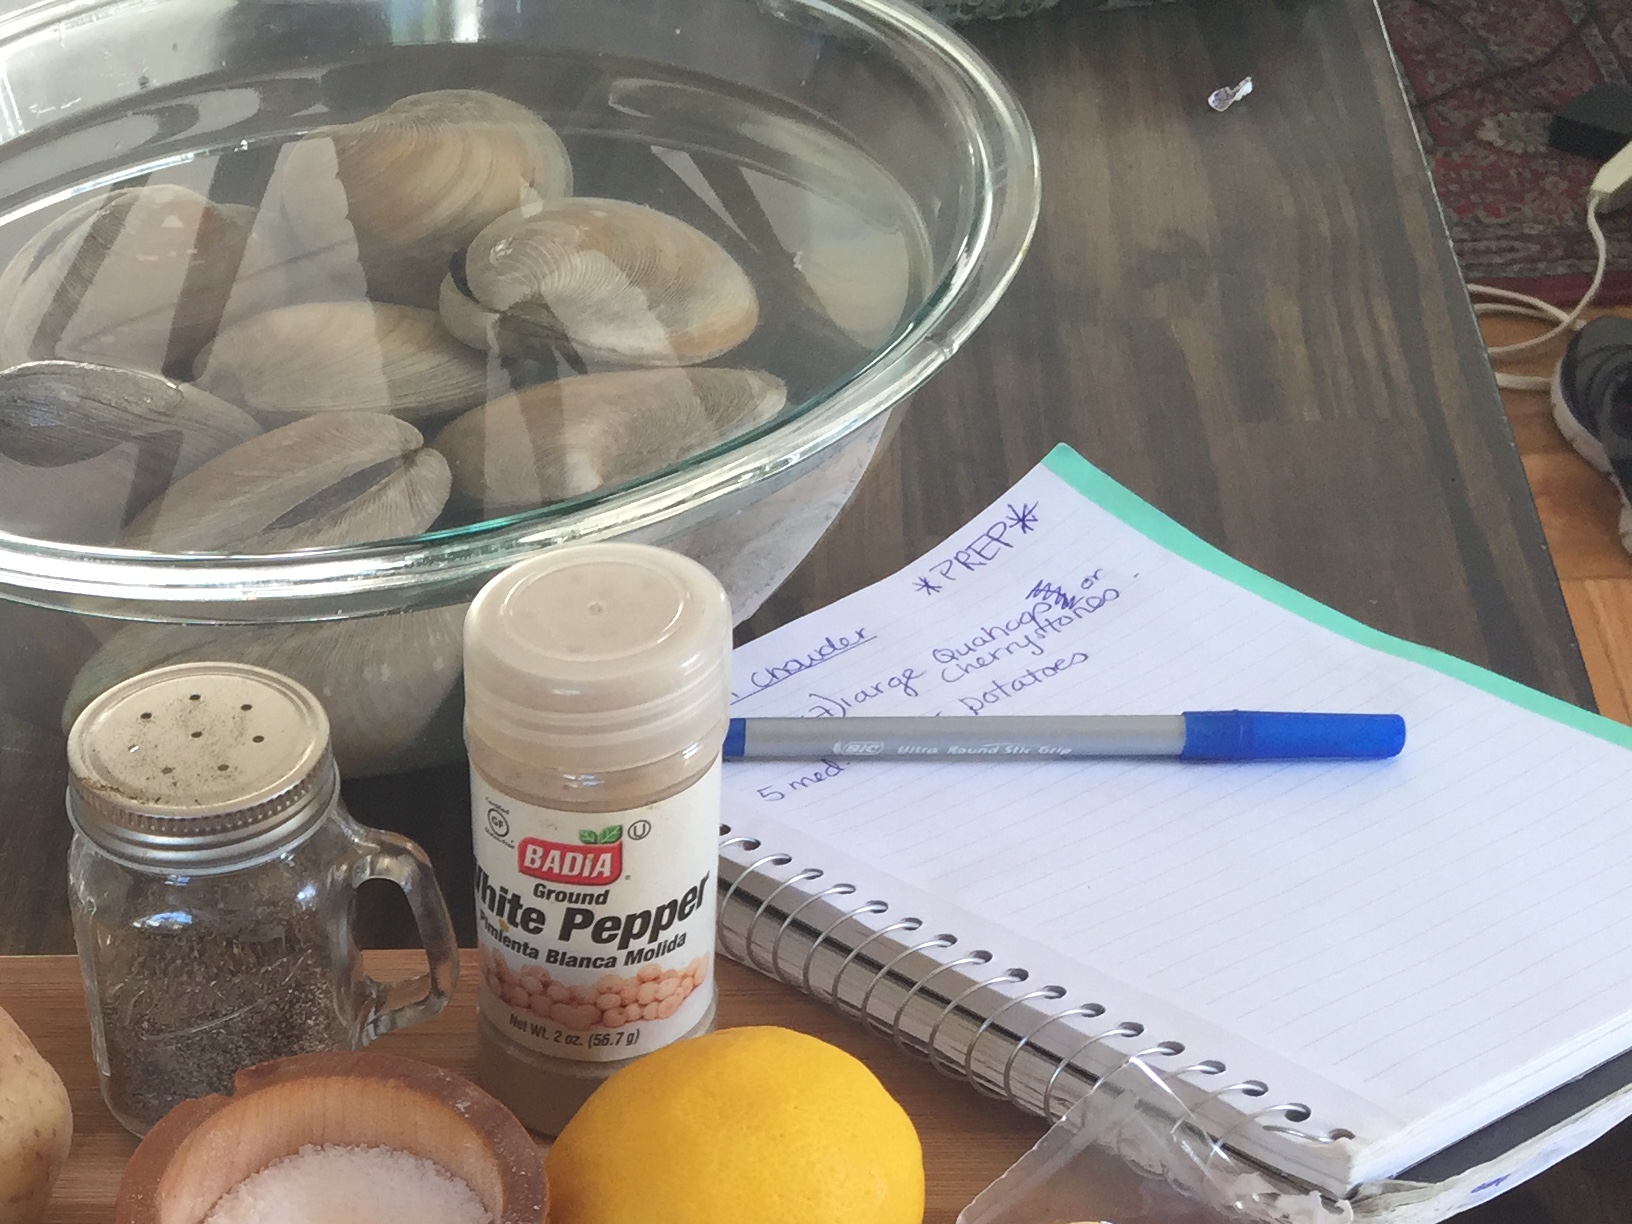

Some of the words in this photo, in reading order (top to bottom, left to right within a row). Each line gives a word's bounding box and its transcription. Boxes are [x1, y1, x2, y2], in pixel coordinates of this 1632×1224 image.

[1080, 568, 1103, 590] or
[757, 785, 785, 801] 5
[959, 651, 1089, 716] potatoes
[1038, 745, 1073, 755] Grip
[523, 844, 613, 878] BADIA
[533, 883, 610, 905] Ground
[558, 870, 710, 950] Pepper
[545, 949, 617, 969] Blanca
[623, 931, 687, 967] Molida
[509, 1013, 528, 1032] Net
[530, 1022, 550, 1041] Wt.
[553, 1029, 562, 1043] 2
[565, 1033, 584, 1046] oz.
[587, 1031, 624, 1049] (56.7
